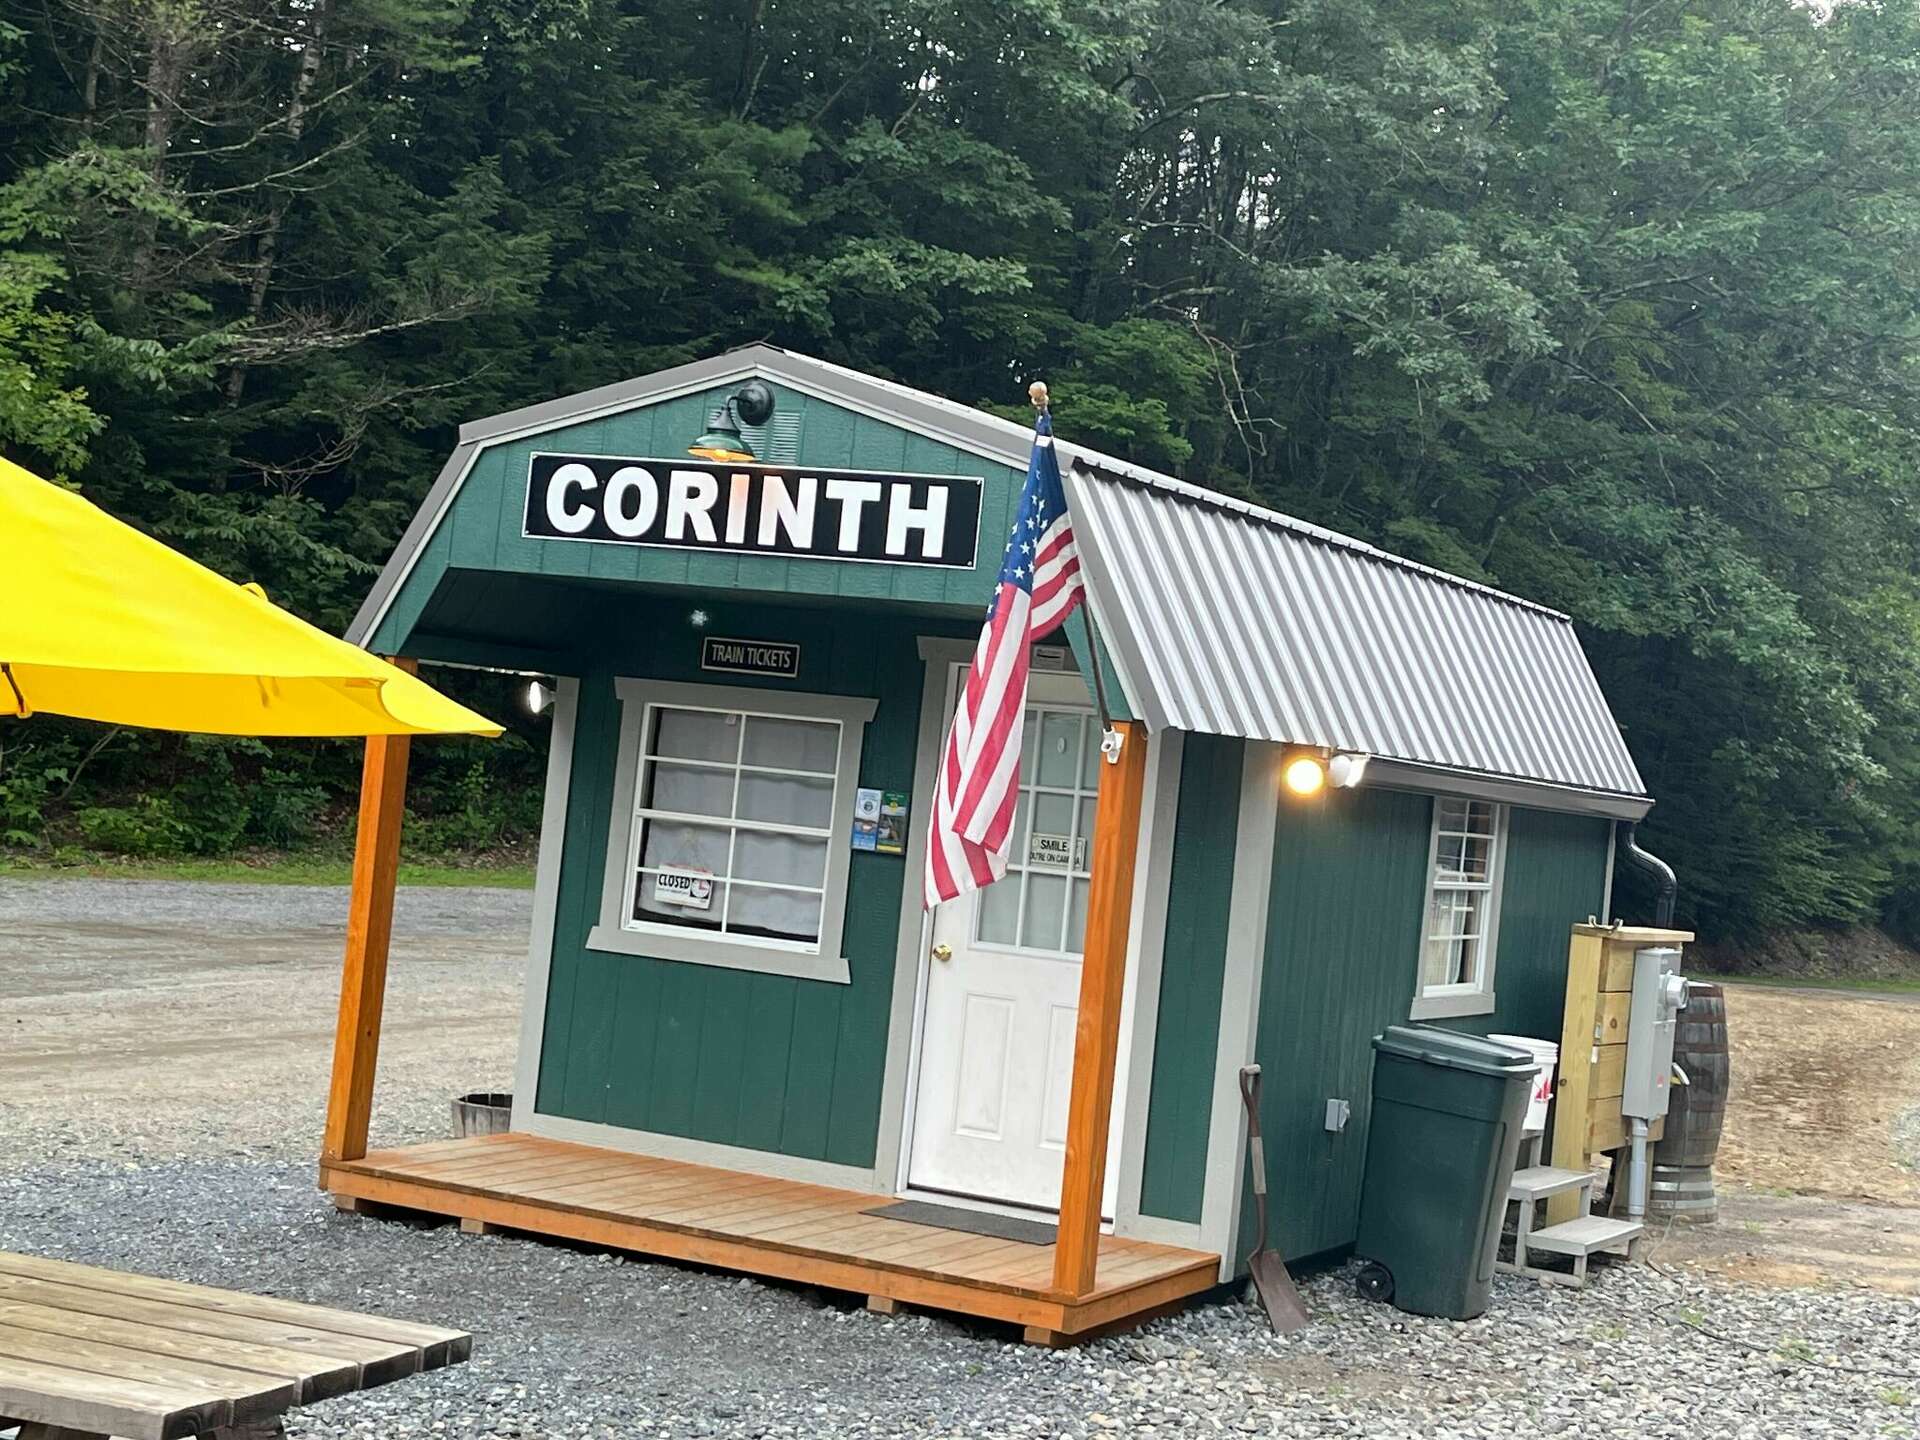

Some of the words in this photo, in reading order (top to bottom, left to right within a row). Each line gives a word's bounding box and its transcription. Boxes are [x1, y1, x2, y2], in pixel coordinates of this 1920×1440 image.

[545, 463, 949, 558] CORINTH
[712, 643, 744, 664] TRAIN
[747, 647, 791, 668] TICKETS
[1041, 839, 1068, 852] SMILE
[658, 874, 691, 889] CLOSED
